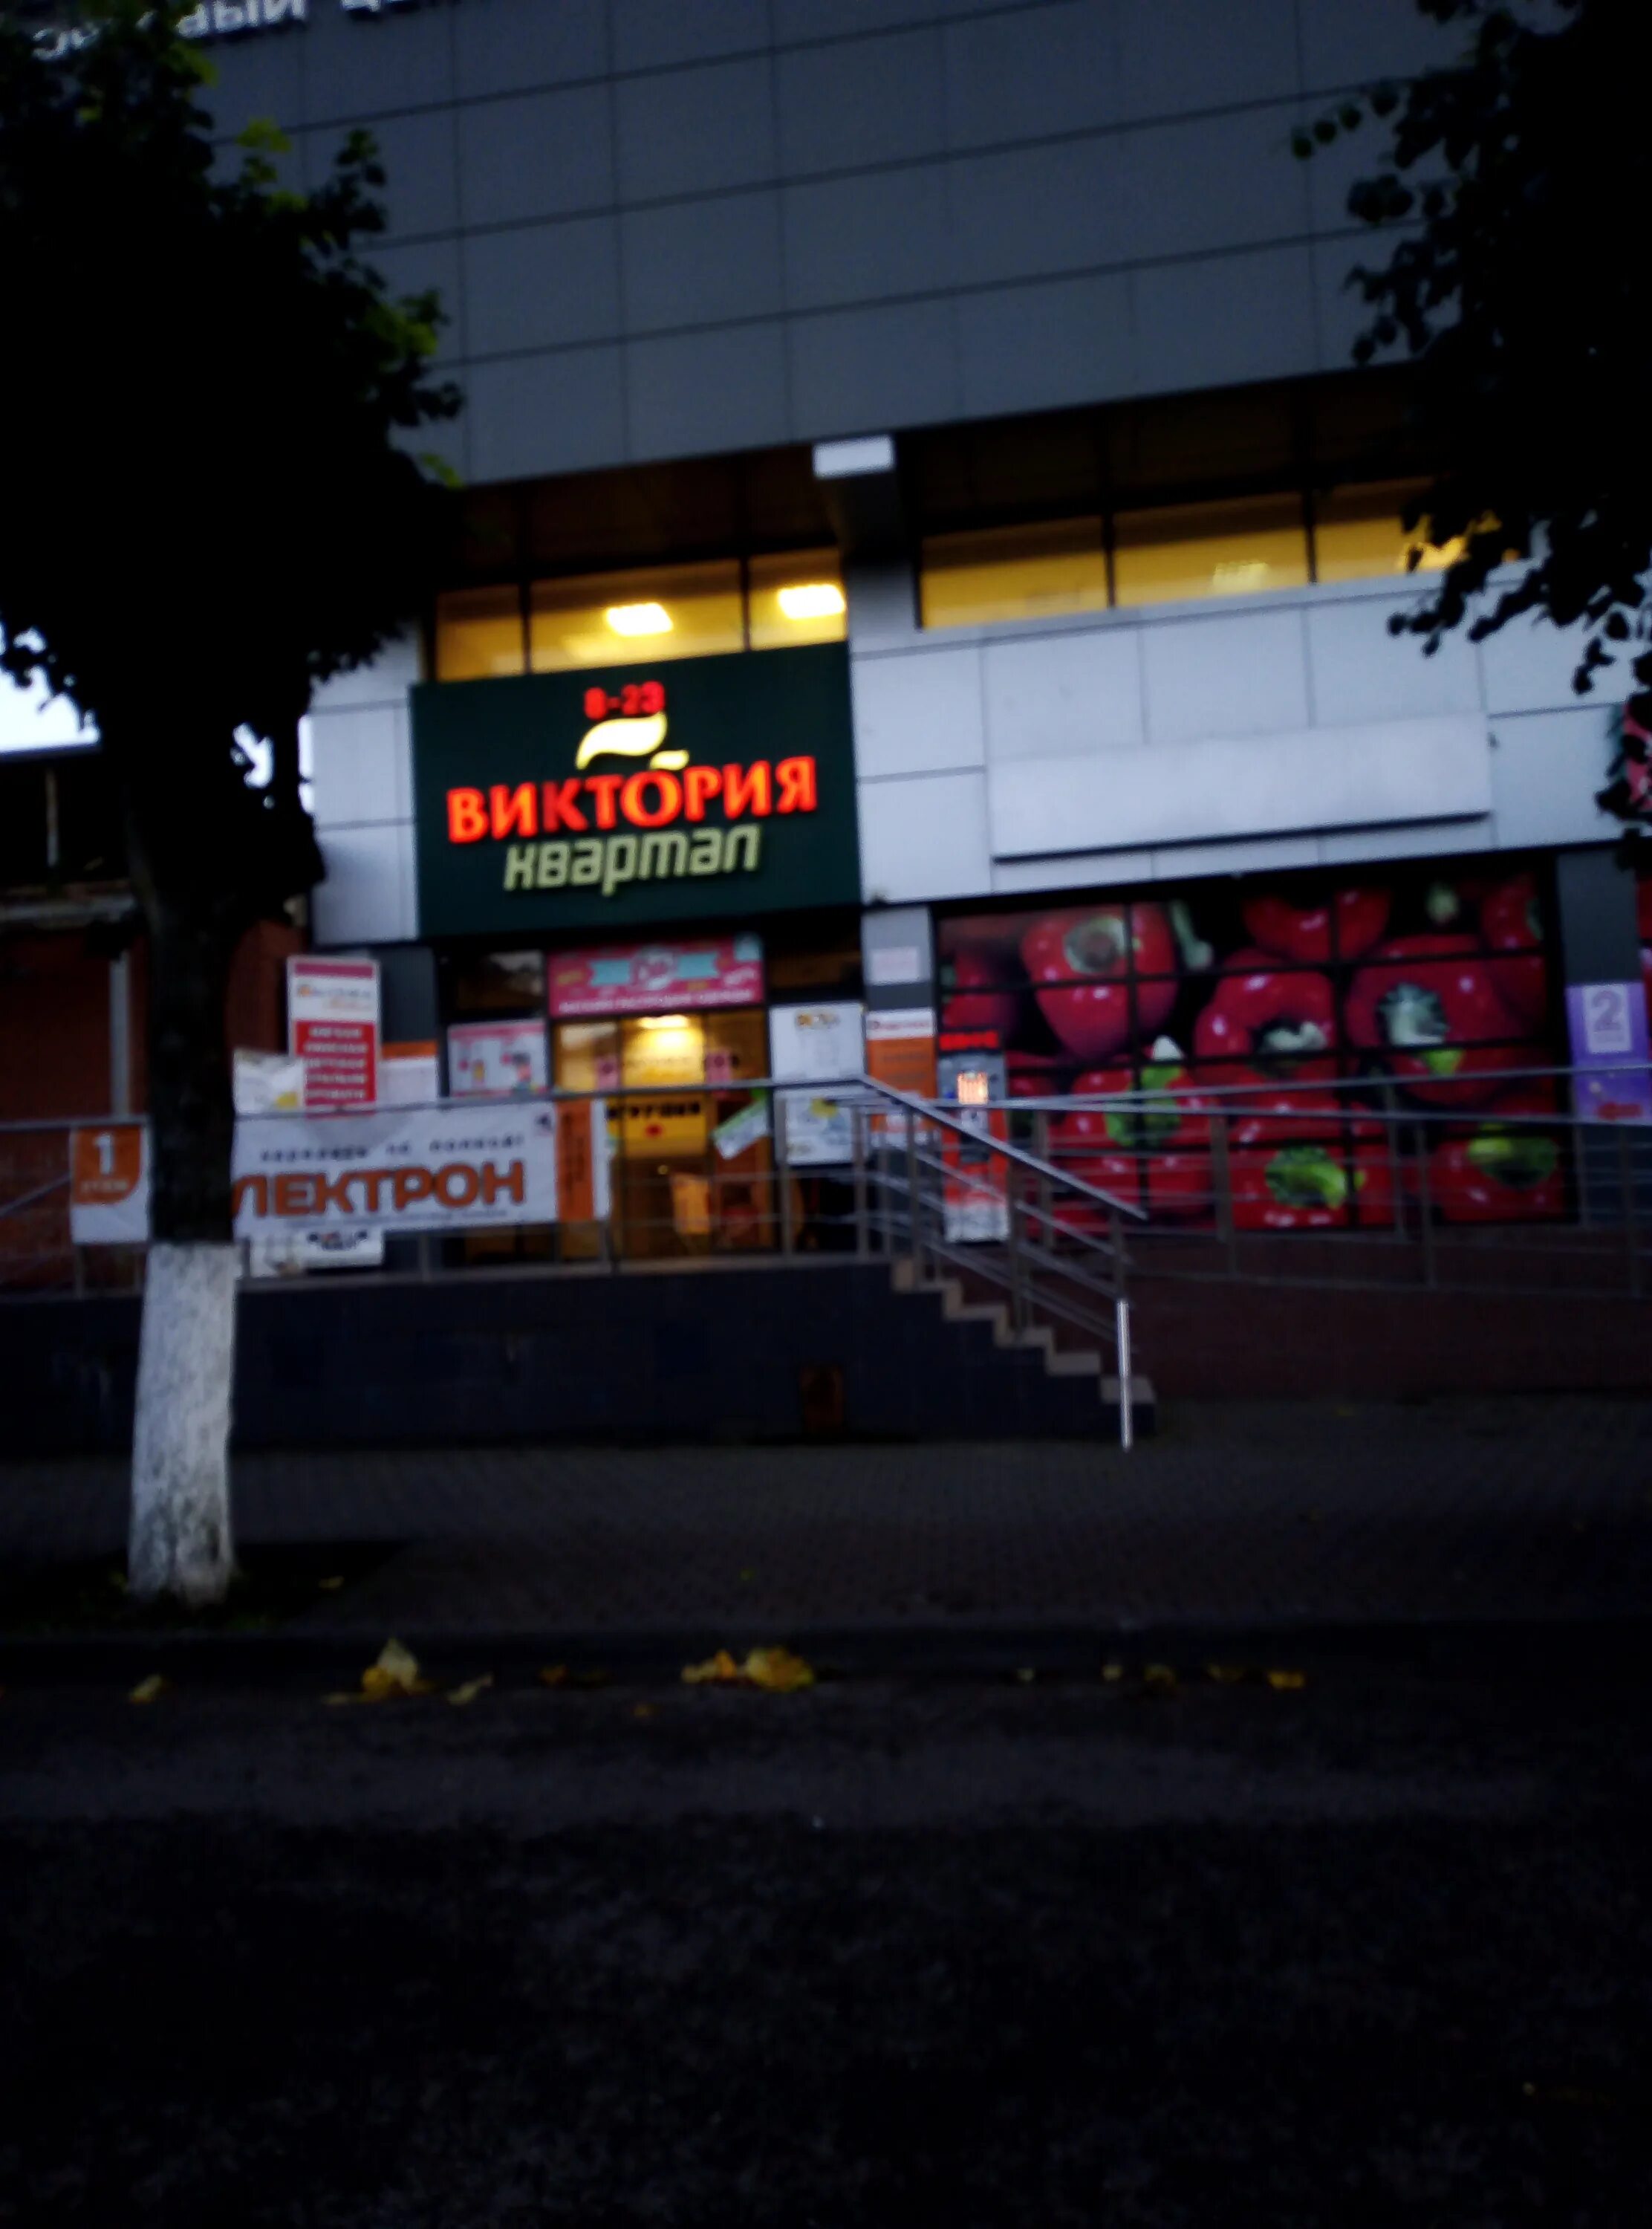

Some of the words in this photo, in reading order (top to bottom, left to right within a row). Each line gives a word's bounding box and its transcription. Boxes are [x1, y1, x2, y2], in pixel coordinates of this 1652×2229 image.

[446, 755, 816, 844] ВИКТОРИЯ
[504, 823, 762, 897] квартал
[1592, 989, 1623, 1032] 2
[94, 1133, 112, 1175] 1
[232, 1158, 524, 1218] ЛЕКТРОН
